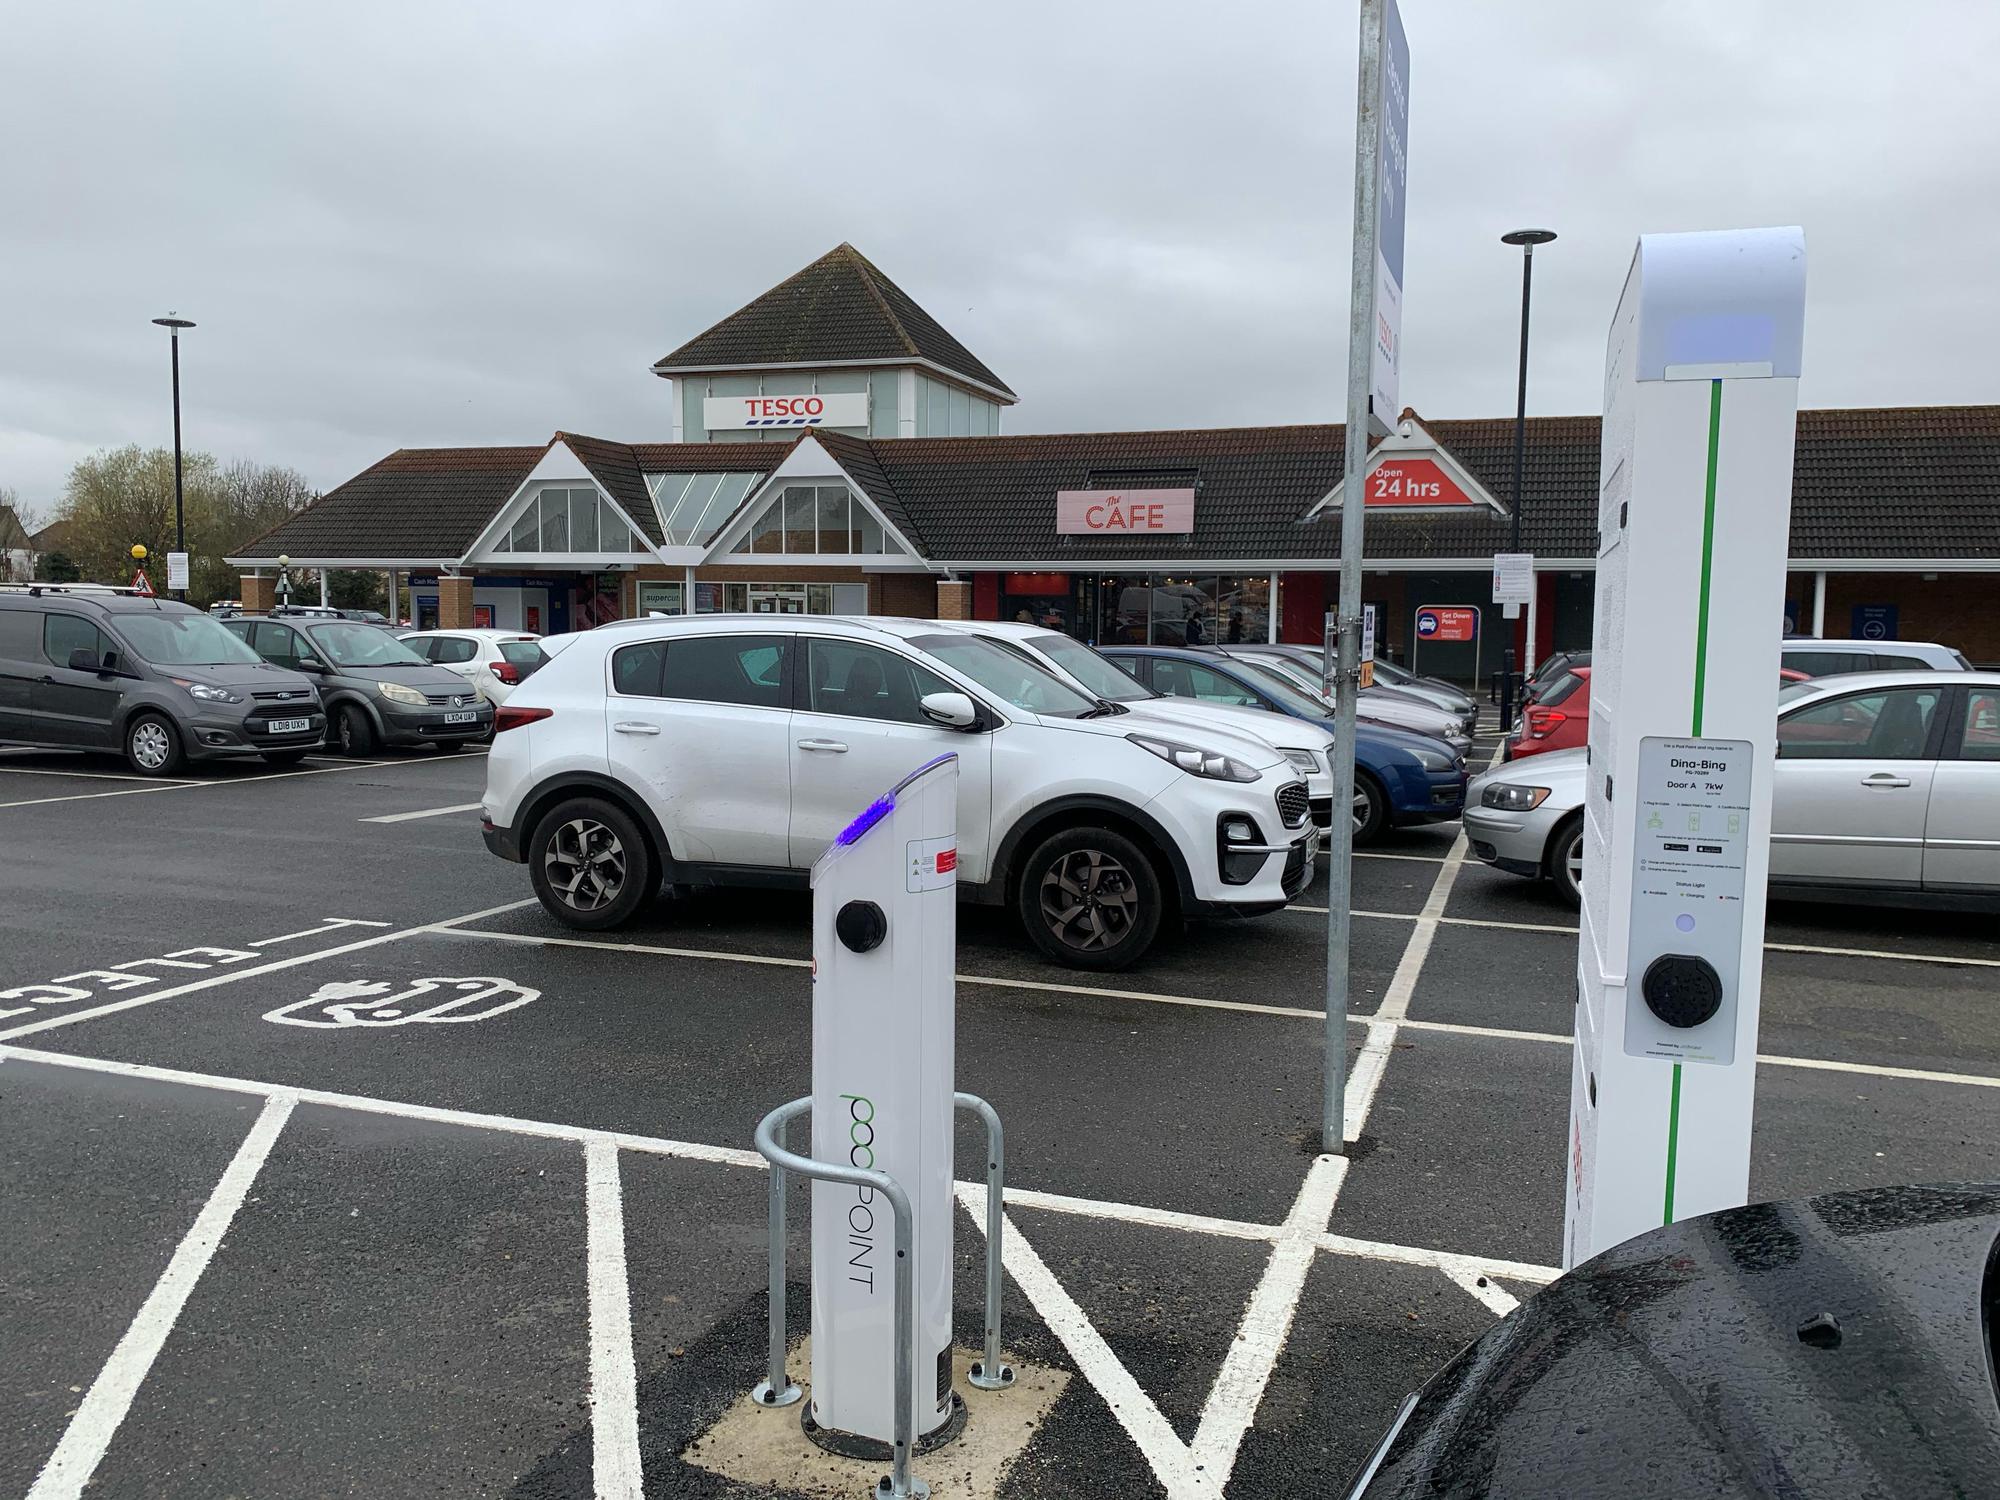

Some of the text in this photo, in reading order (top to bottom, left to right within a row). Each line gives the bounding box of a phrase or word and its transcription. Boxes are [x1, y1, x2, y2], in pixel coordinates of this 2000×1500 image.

[1387, 38, 1405, 119] Electric
[1385, 100, 1405, 189] Charging
[1383, 159, 1394, 219] Only
[1378, 311, 1393, 352] TESCO
[745, 398, 824, 417] TESCO
[1375, 468, 1403, 479] Open
[1374, 478, 1440, 497] 24 hrs
[1085, 504, 1164, 529] CAFE
[273, 719, 306, 731] LD18 UXH
[1670, 758, 1727, 772] Dina-Bing
[1667, 781, 1689, 789] Door
[1705, 782, 1724, 790] 7kW
